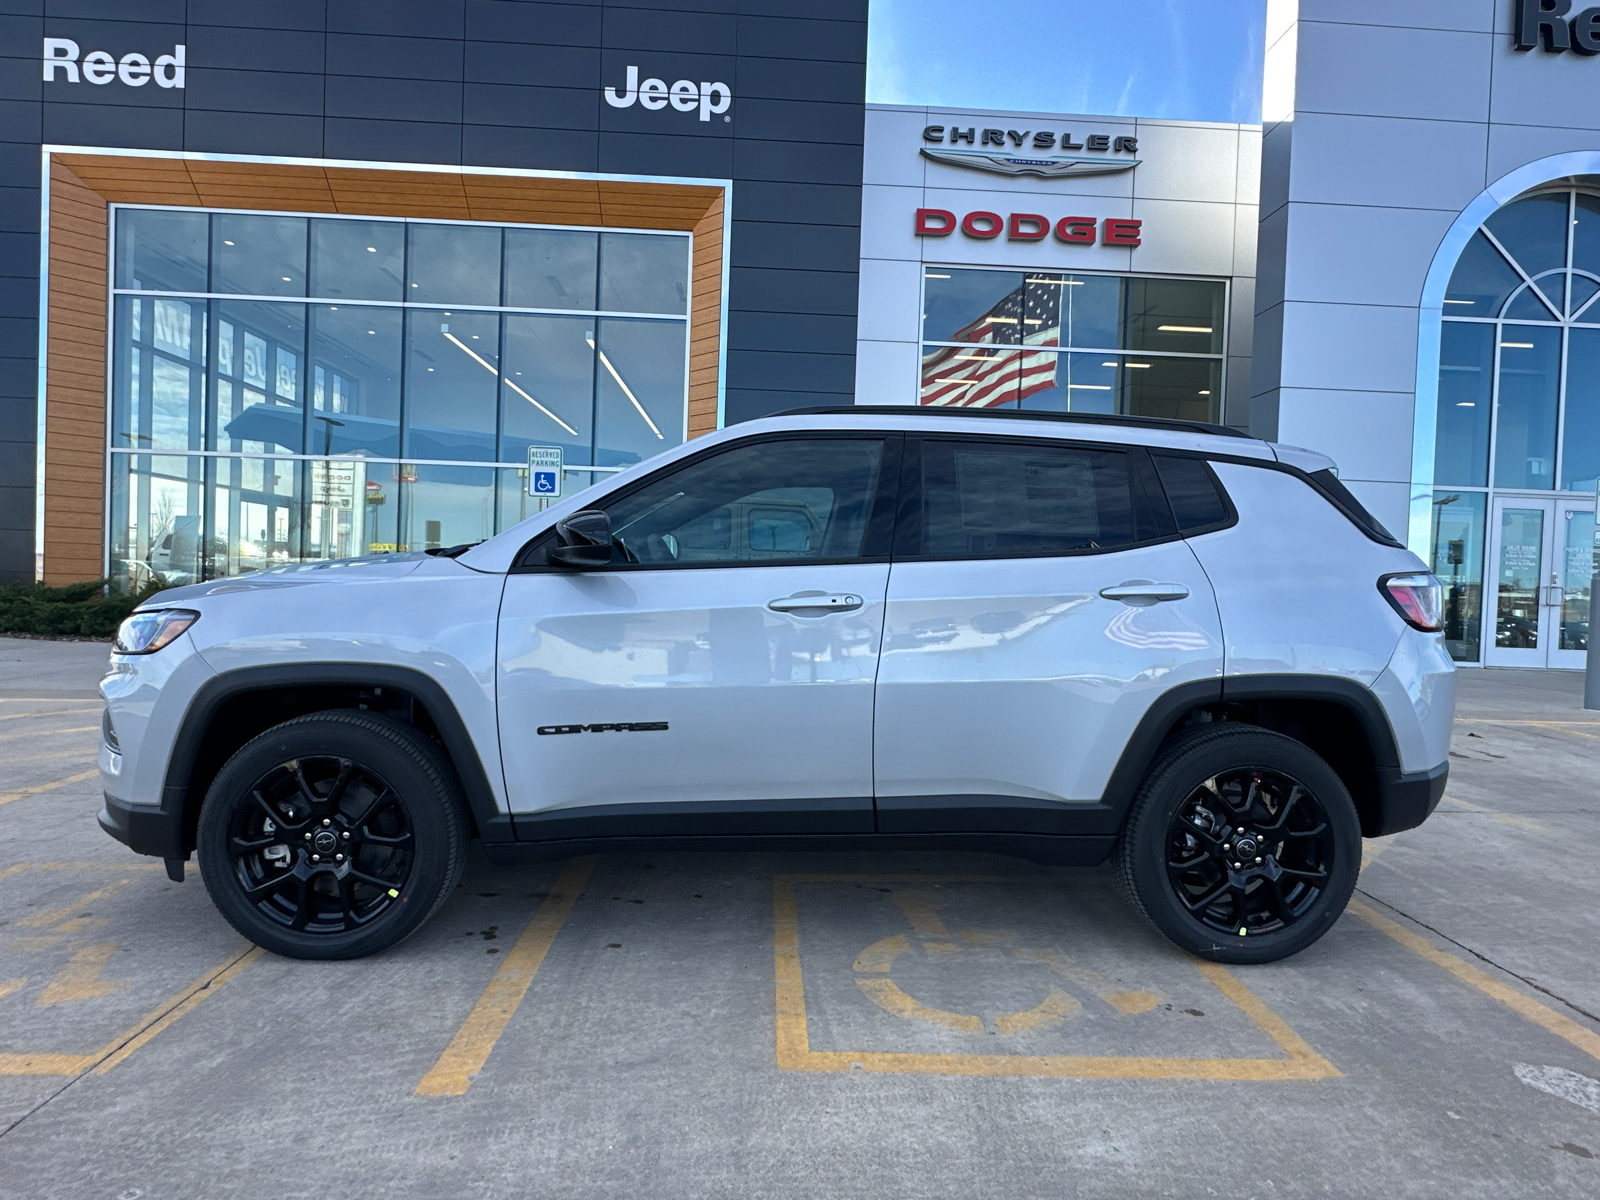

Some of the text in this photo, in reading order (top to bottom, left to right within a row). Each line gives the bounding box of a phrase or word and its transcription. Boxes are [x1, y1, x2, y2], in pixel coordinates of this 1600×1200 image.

[43, 37, 186, 89] Reed
[604, 65, 731, 122] Jeep
[922, 125, 1138, 152] CHRYSLER
[915, 207, 1142, 248] DODGE
[531, 451, 560, 459] RESERVED
[531, 459, 560, 468] PARKING
[537, 722, 669, 735] COMPASS
